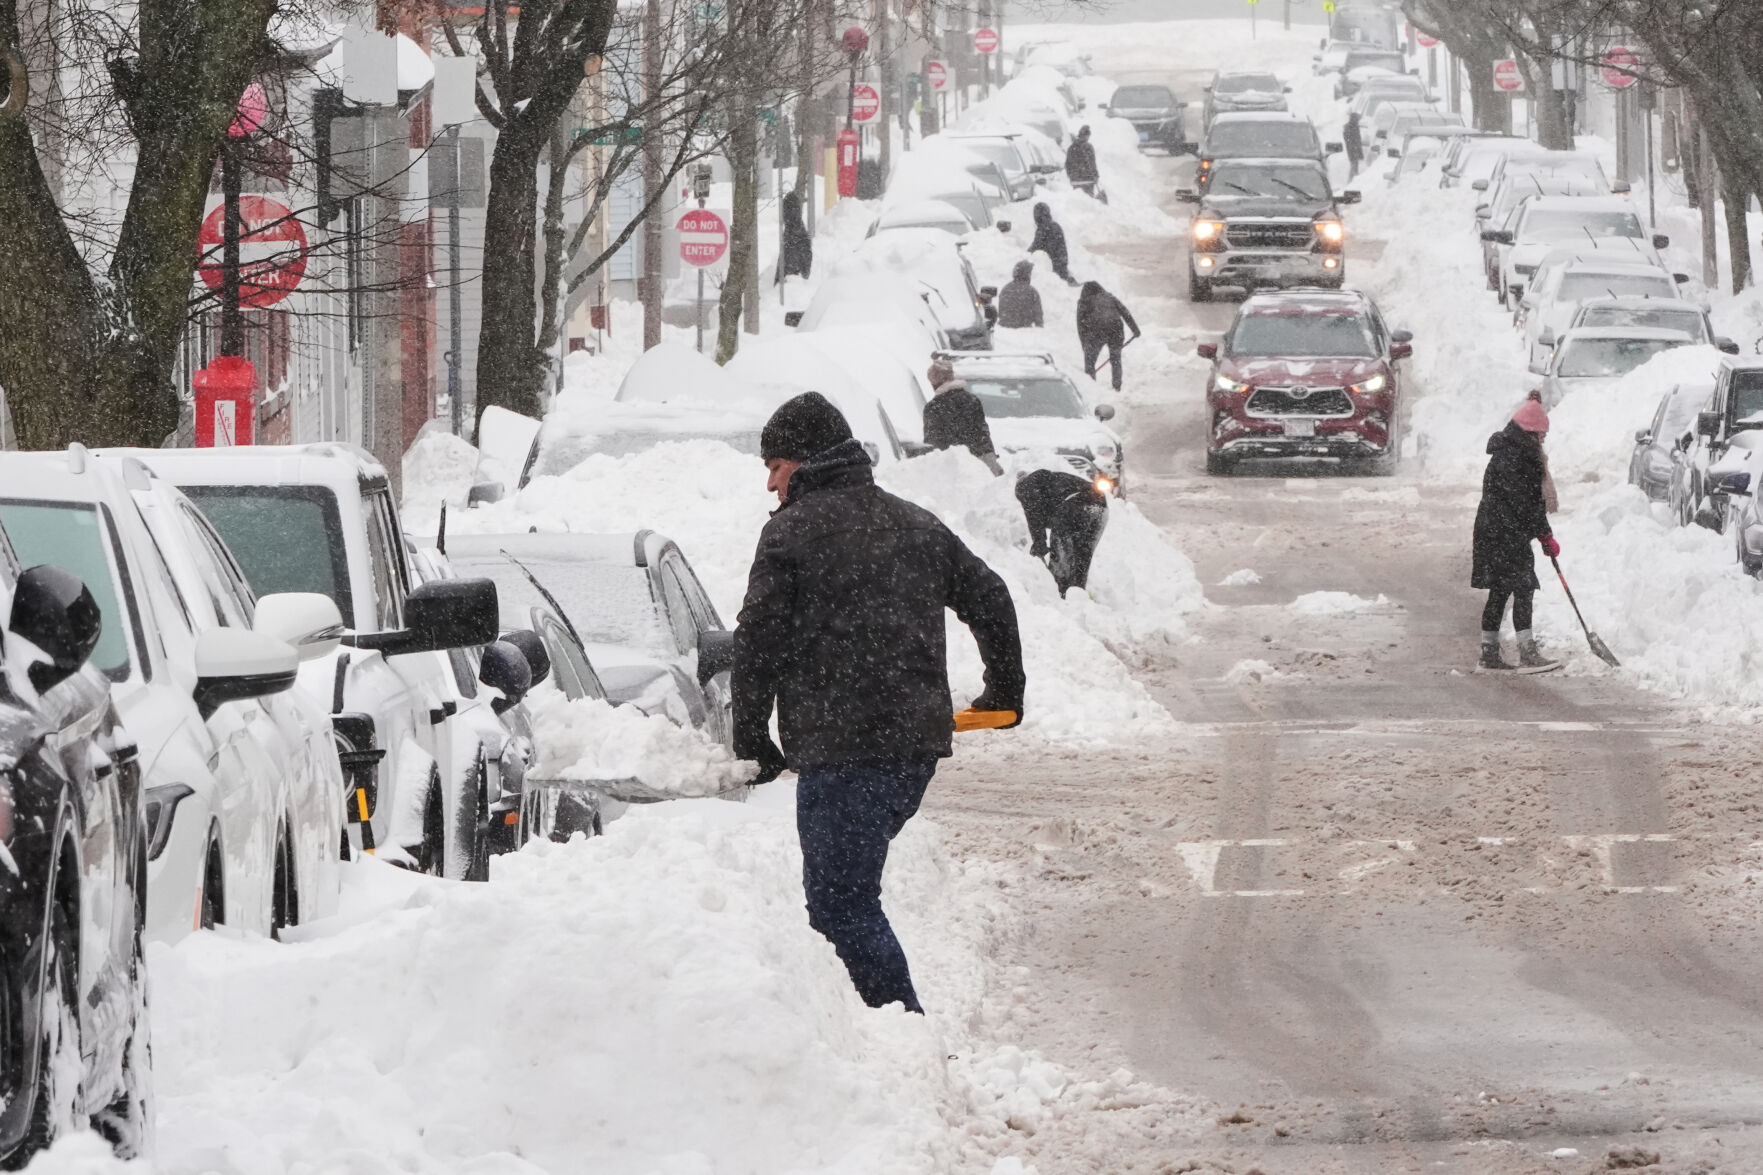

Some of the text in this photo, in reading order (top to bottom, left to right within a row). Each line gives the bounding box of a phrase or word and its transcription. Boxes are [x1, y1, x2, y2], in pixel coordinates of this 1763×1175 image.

[683, 220, 718, 230] DO NOT
[685, 245, 716, 256] ENTER
